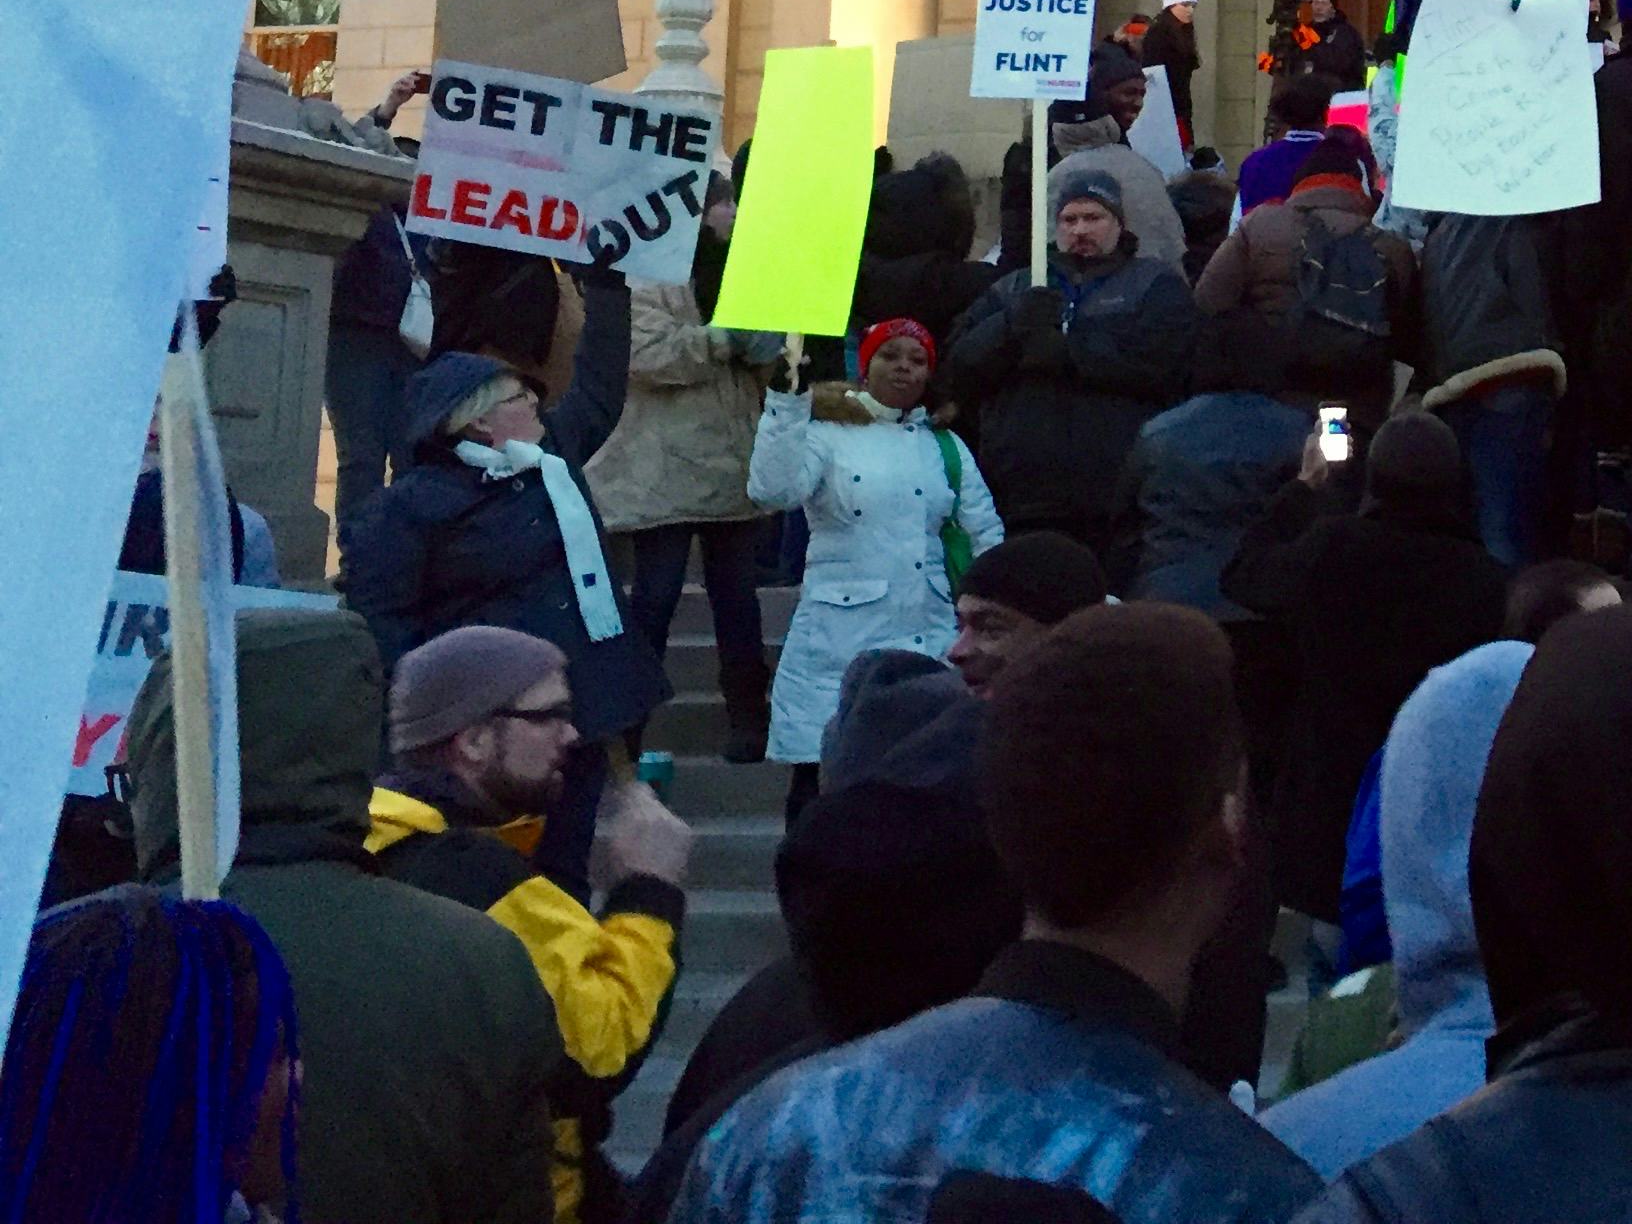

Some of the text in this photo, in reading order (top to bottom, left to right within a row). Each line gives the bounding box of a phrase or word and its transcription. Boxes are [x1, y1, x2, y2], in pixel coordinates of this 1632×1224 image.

[996, 52, 1067, 73] FLINT
[1021, 26, 1046, 42] for
[431, 75, 711, 163] GET THE
[411, 173, 579, 241] LEAD
[587, 170, 703, 267] OUT
